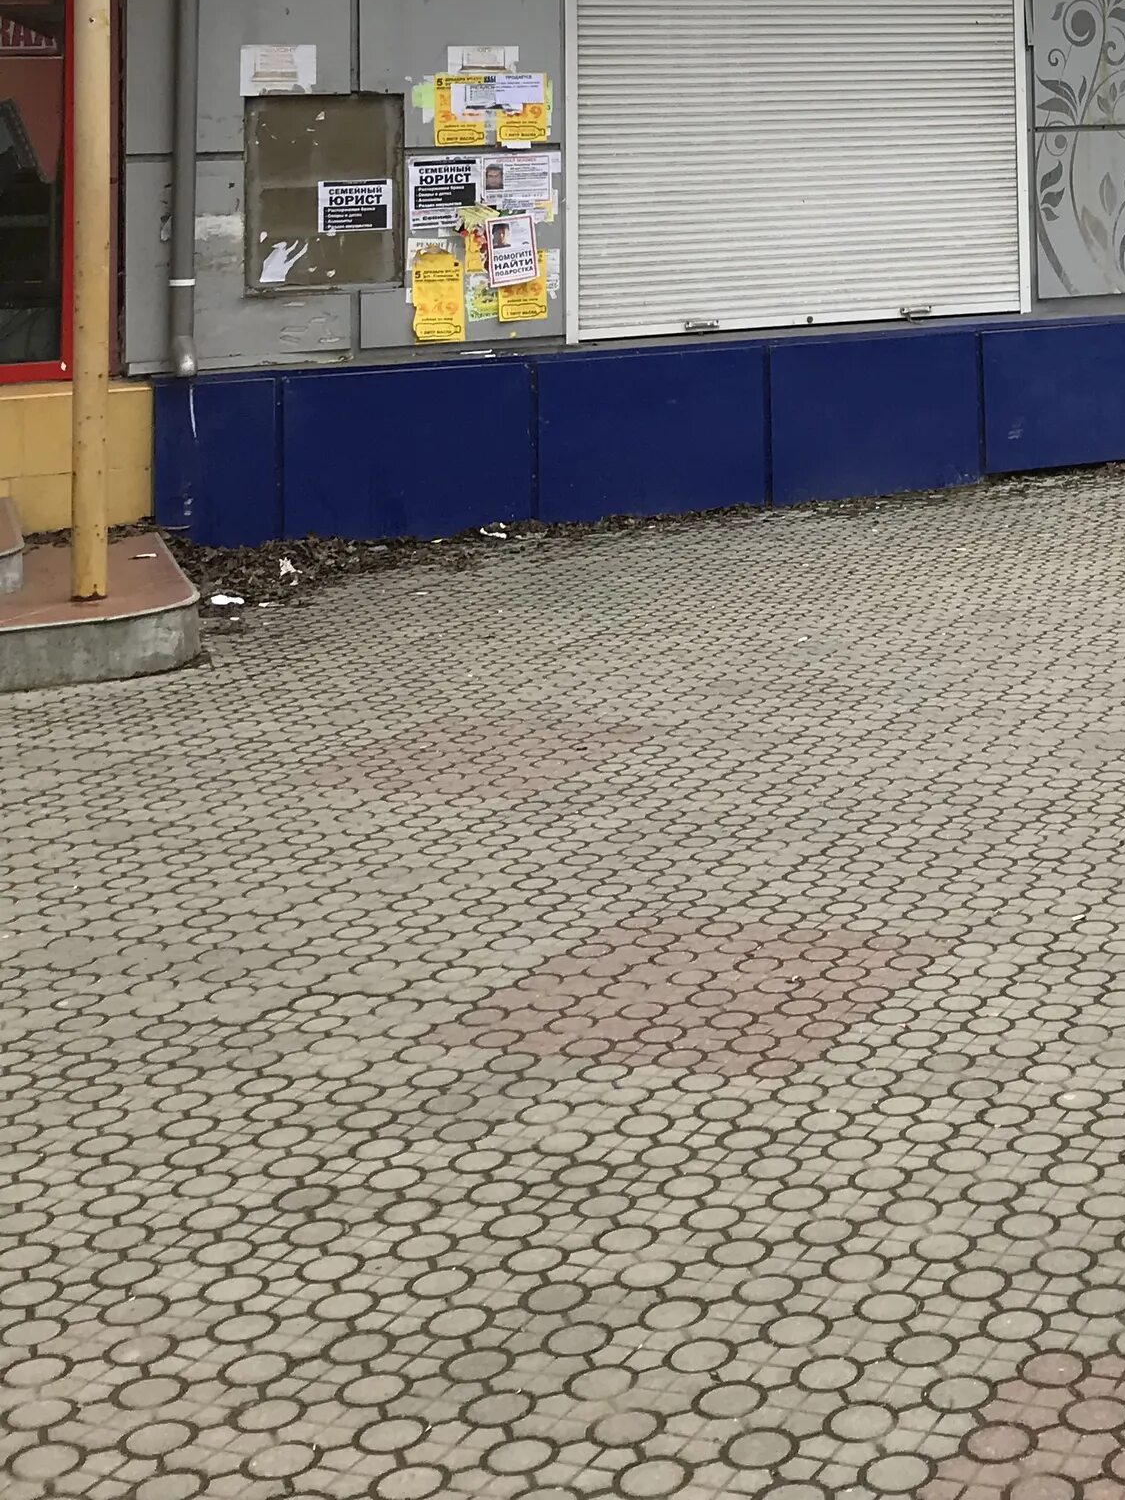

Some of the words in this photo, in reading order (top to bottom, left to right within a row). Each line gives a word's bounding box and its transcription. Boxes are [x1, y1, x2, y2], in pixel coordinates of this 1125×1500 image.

[418, 165, 471, 175] СЕМЕЙНЫЙ
[419, 173, 471, 185] ЮРИСТ
[328, 186, 382, 195] СЕМЕЙНЫЙ
[329, 194, 382, 206] ЮРИСТ
[493, 250, 532, 262] ПОМОГИТЕ
[494, 258, 533, 271] НАЙТИ
[494, 266, 534, 277] ПОДРОСТКА
